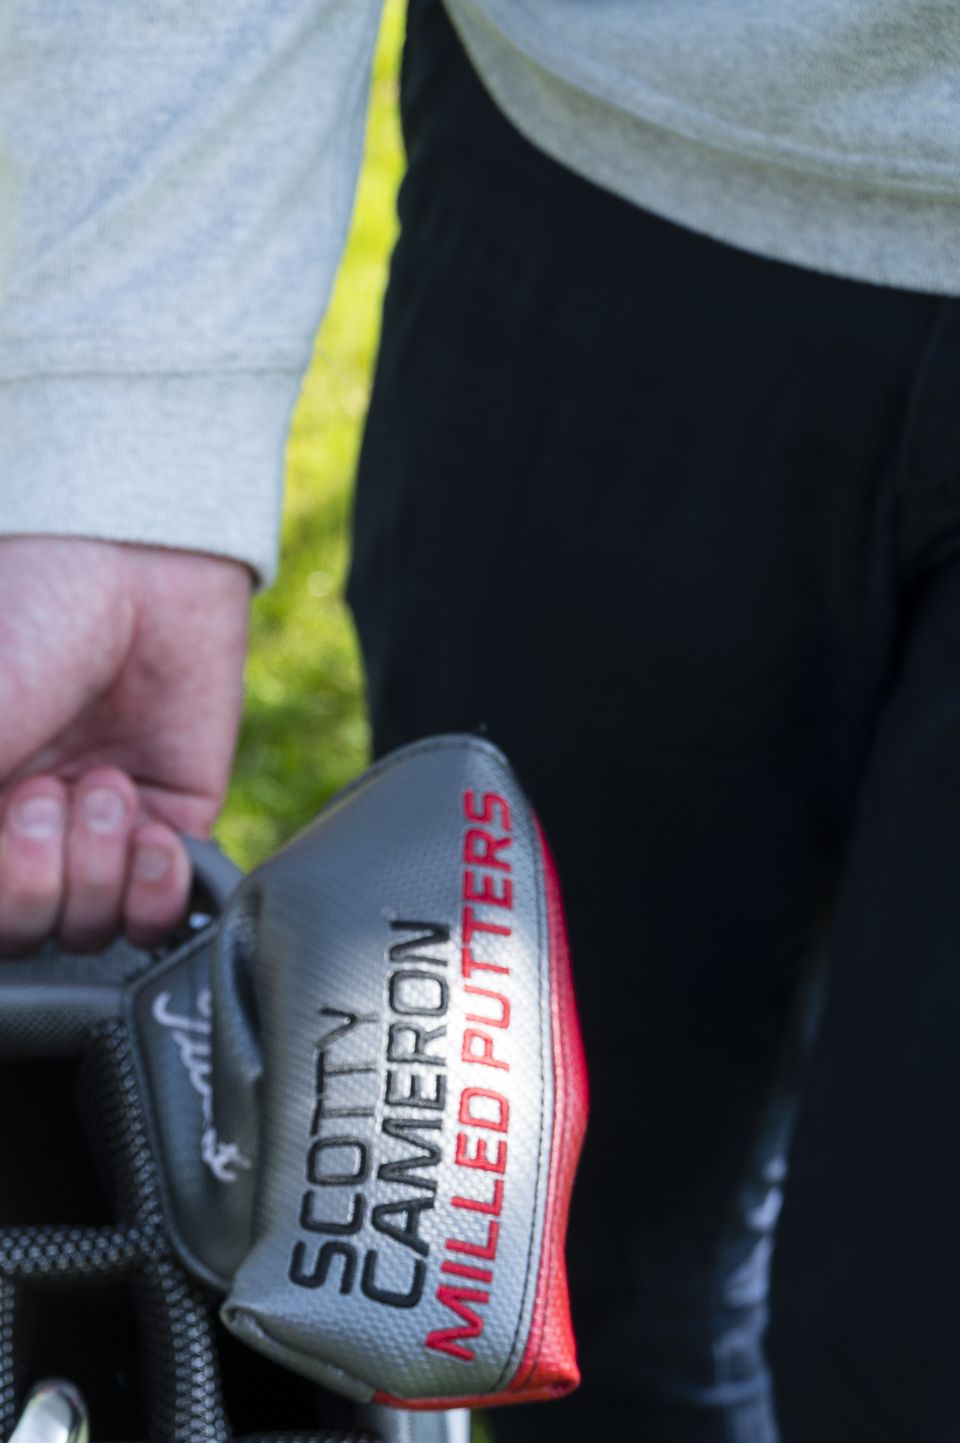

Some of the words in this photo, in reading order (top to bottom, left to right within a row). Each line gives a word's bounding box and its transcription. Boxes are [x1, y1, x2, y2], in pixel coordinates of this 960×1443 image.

[461, 788, 513, 1073] PUTTERS
[288, 1006, 381, 1296] SCOTTY
[359, 917, 451, 1309] CAMERON
[425, 1087, 511, 1363] MILLED
